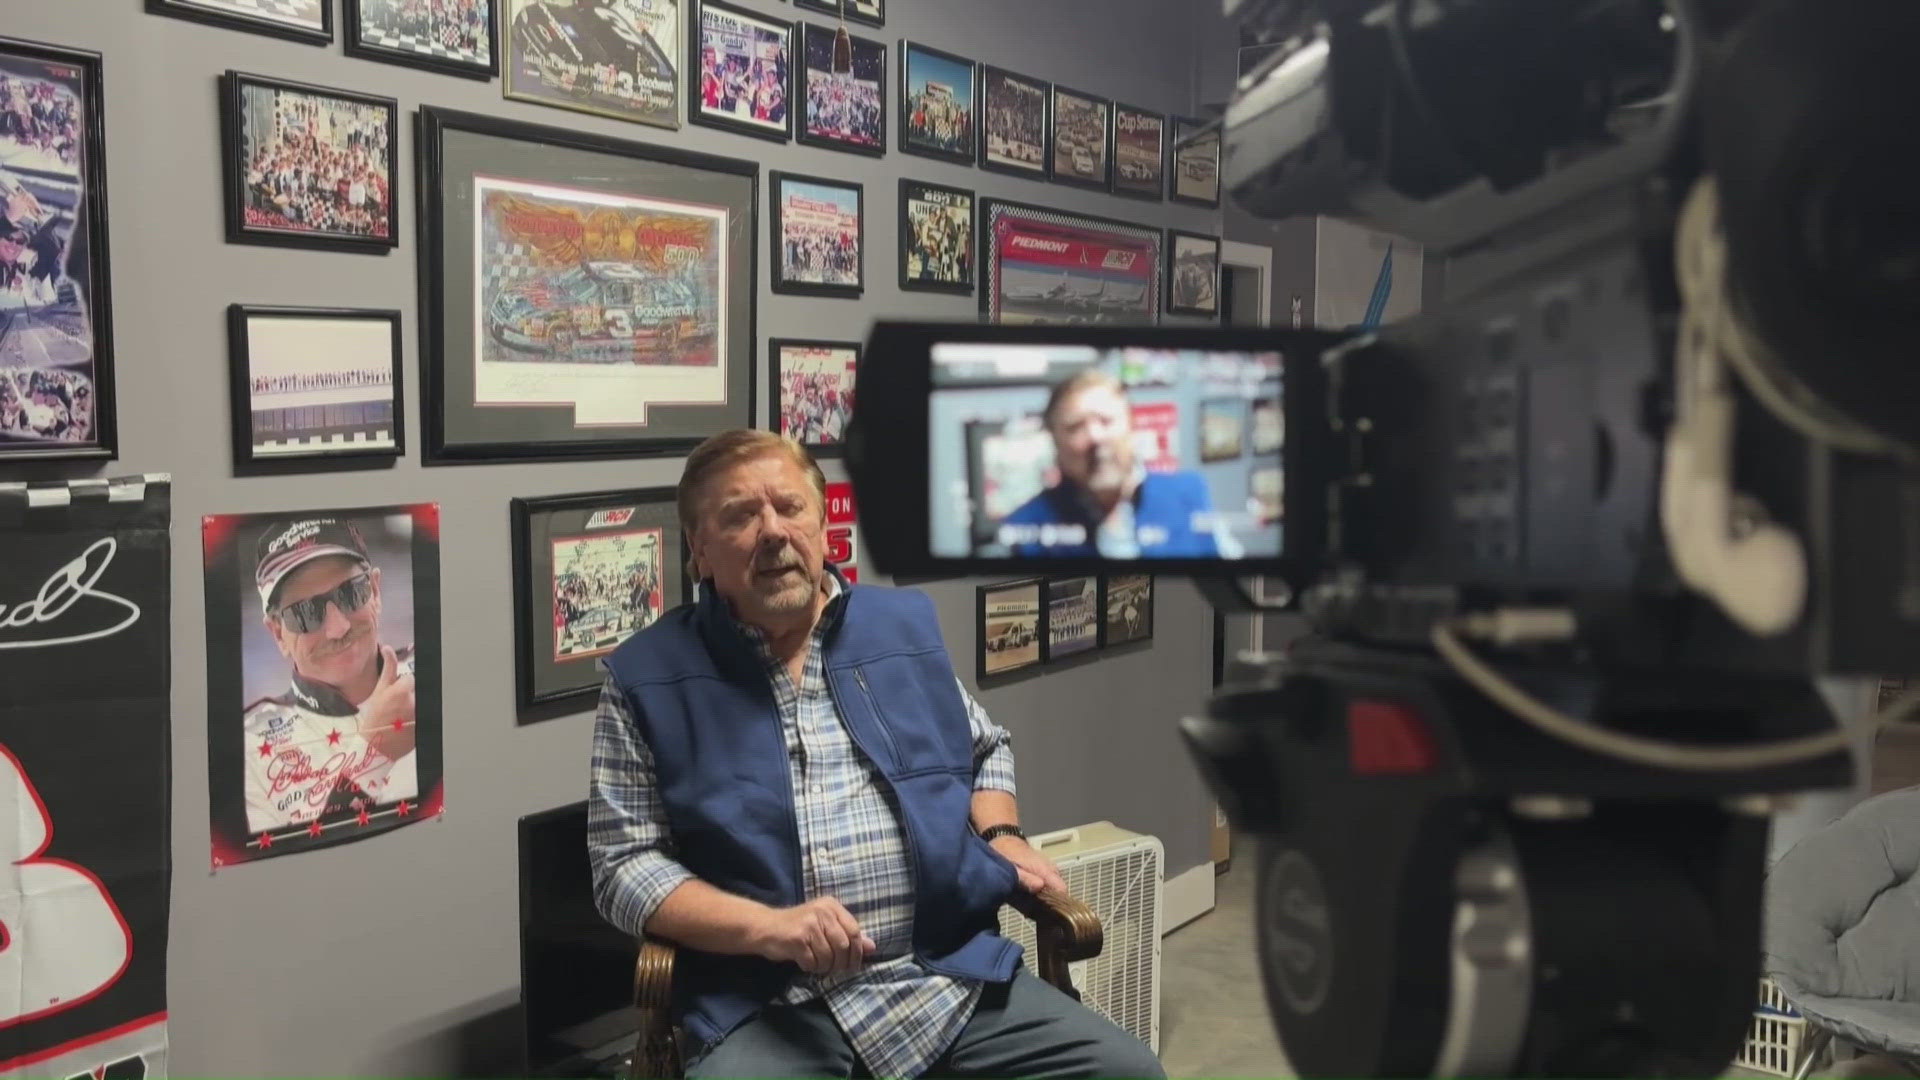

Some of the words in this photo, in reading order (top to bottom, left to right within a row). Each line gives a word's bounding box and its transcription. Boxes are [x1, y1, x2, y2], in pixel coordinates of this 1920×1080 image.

[1117, 112, 1136, 134] Cup
[663, 243, 703, 264] 500
[1011, 235, 1070, 254] PIEDMONT
[604, 308, 633, 338] 3
[826, 527, 853, 564] 5
